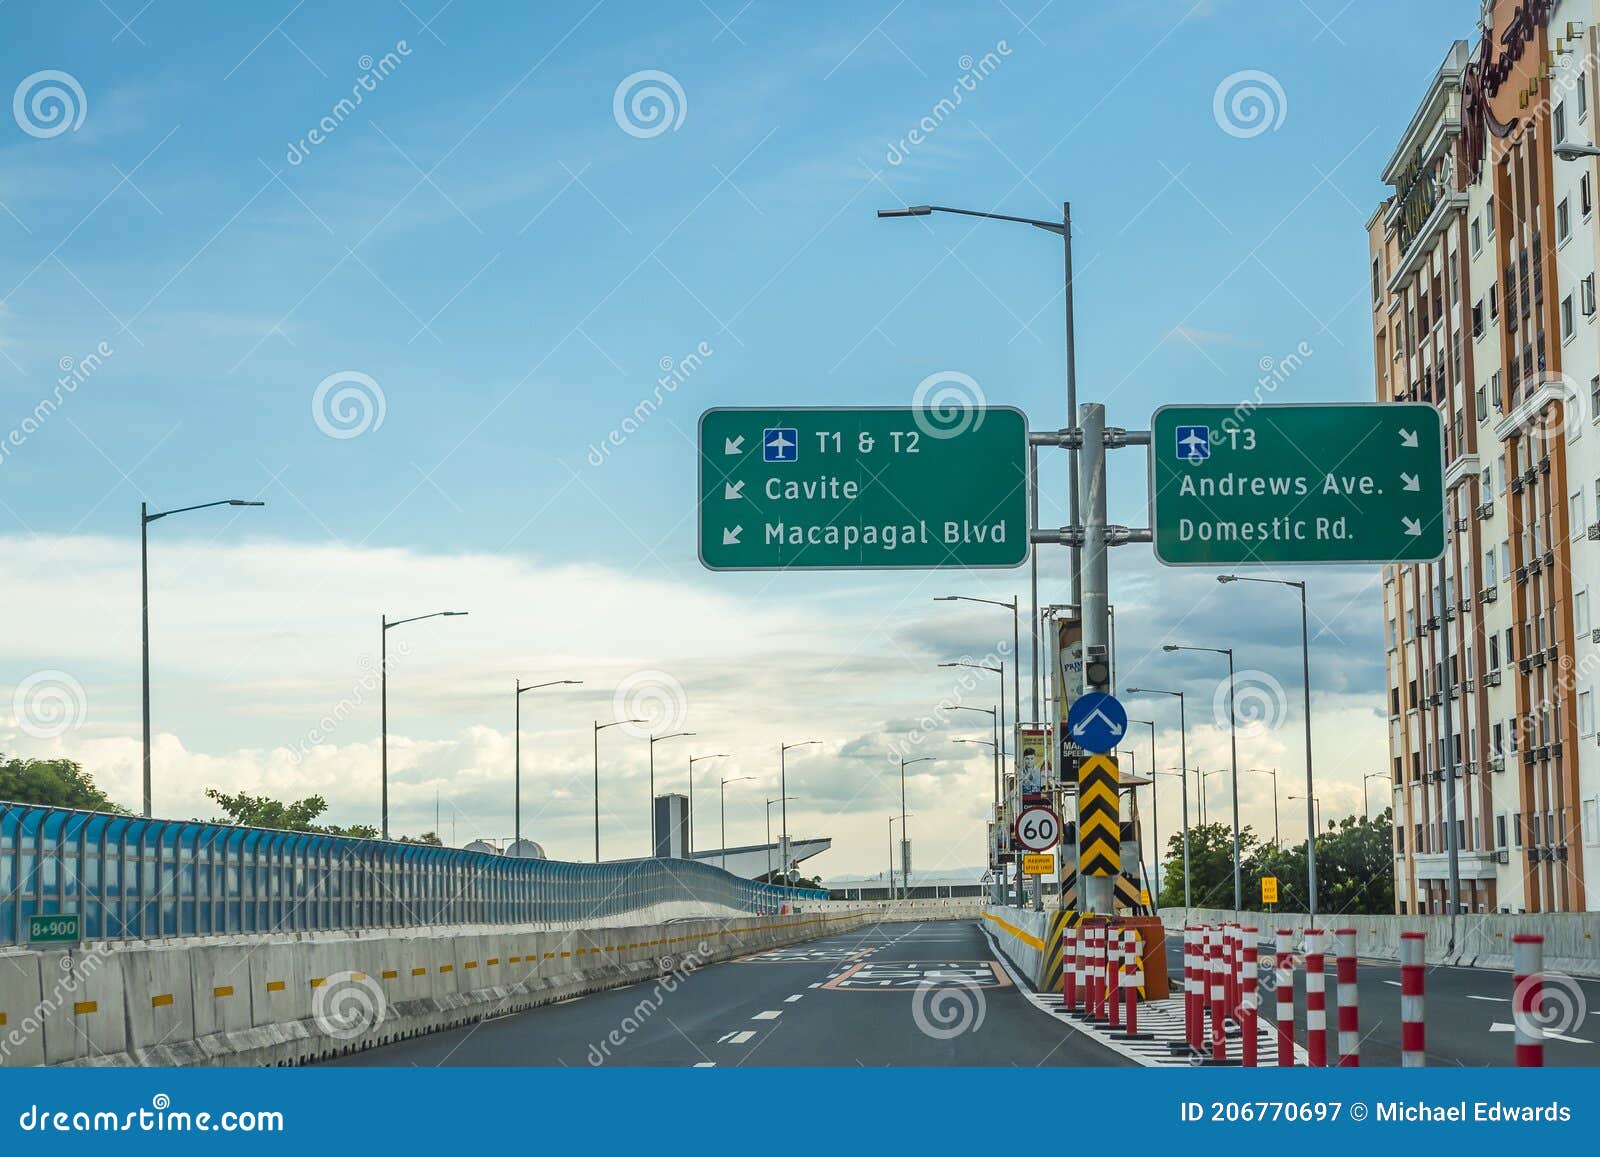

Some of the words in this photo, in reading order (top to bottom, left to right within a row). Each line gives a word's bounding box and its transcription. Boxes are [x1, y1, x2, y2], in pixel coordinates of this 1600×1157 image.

[816, 431, 842, 453] T1
[858, 431, 875, 453] &
[890, 431, 920, 453] T2
[1227, 428, 1256, 450] T3
[765, 476, 858, 500] Cavite
[1179, 473, 1308, 496] Andrews
[1323, 473, 1383, 495] Ave.
[765, 521, 928, 550] Macapagal
[944, 520, 1006, 544] Blvd
[1179, 517, 1305, 541] Domestic
[1316, 517, 1353, 540] Rd.
[1023, 819, 1053, 840] 60
[32, 921, 75, 936] 8+900
